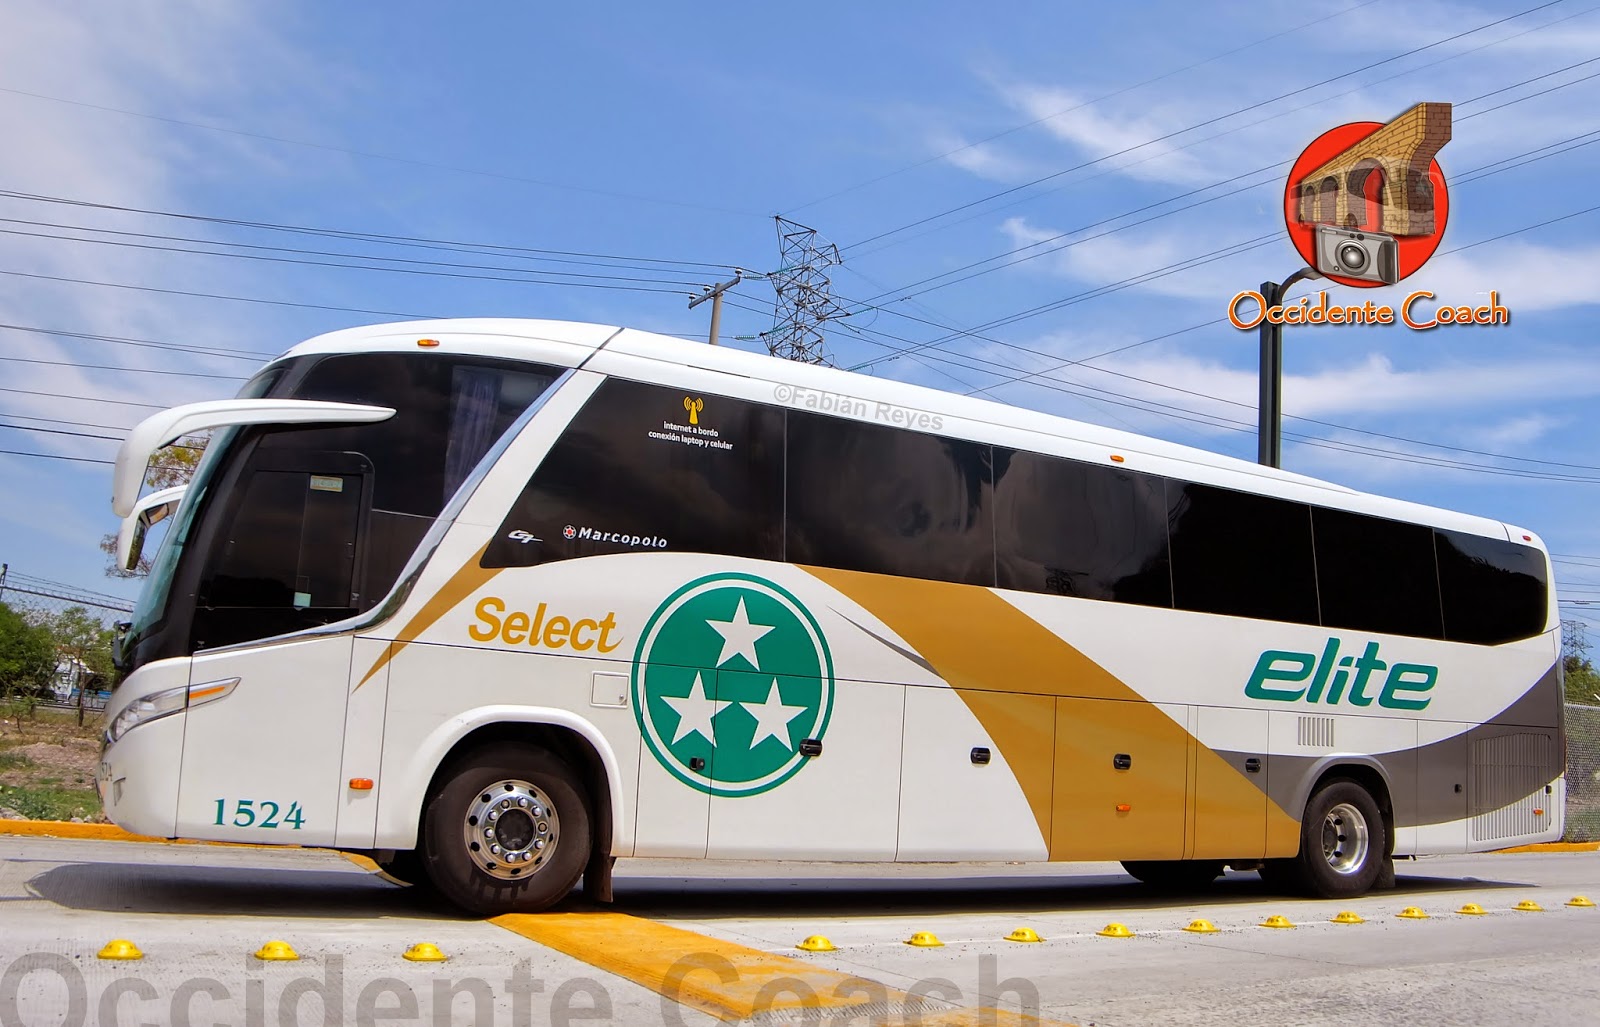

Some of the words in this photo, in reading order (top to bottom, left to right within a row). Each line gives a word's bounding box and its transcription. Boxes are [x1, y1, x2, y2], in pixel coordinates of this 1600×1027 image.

[648, 430, 681, 442] conexión
[681, 434, 704, 447] laptop
[704, 440, 710, 448] y
[710, 440, 734, 450] celular
[692, 426, 698, 434] a
[698, 426, 719, 437] bordo
[578, 526, 668, 548] Marcopolo
[468, 596, 624, 654] Select
[1244, 637, 1439, 710] elite
[212, 798, 306, 830] 1524
